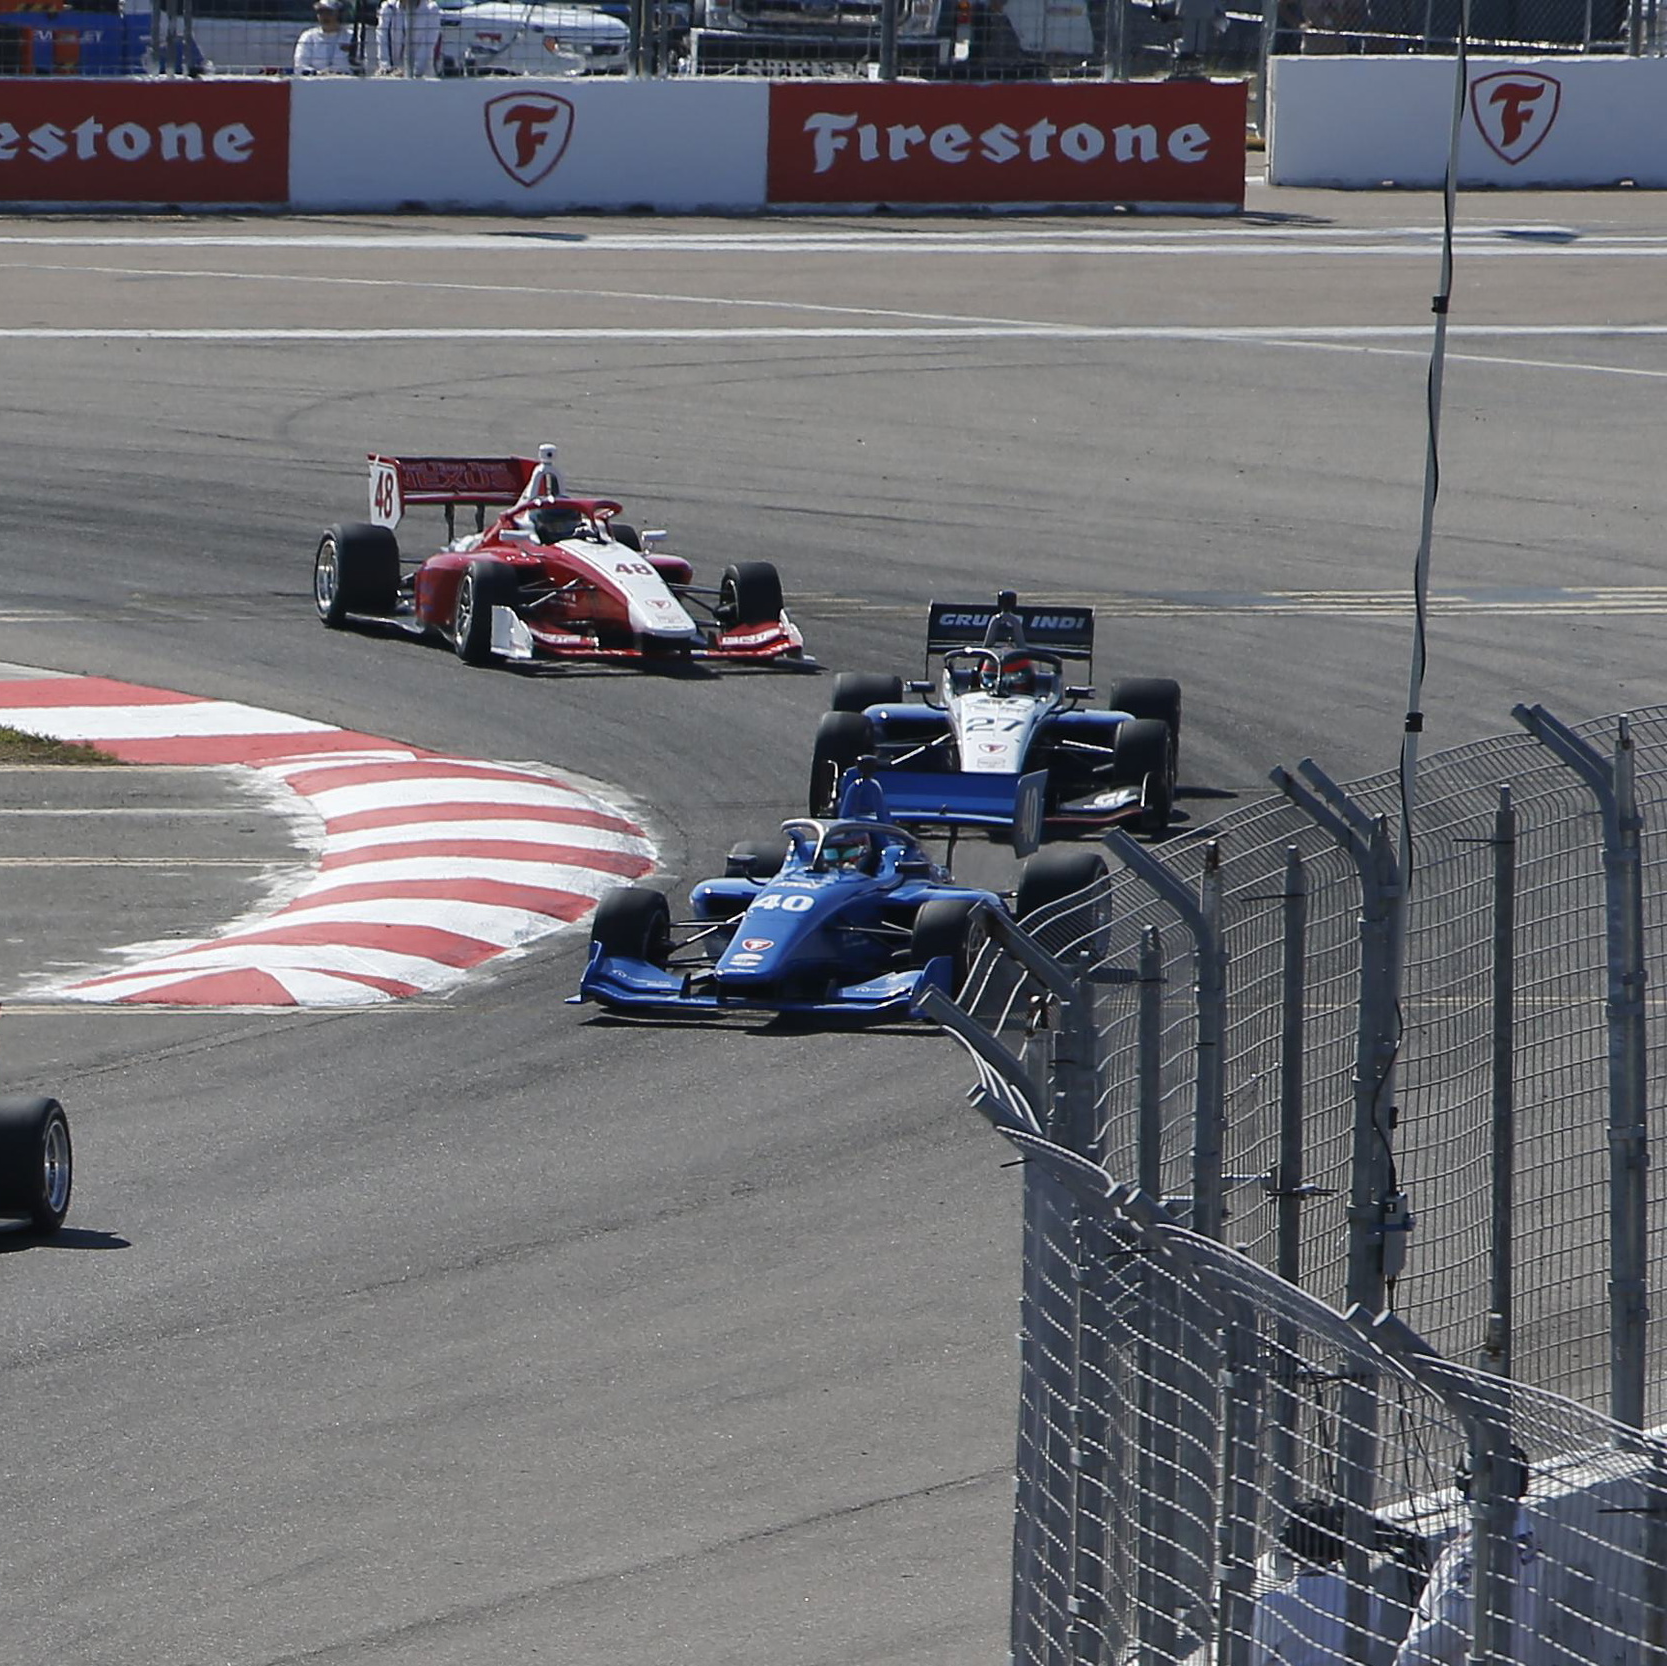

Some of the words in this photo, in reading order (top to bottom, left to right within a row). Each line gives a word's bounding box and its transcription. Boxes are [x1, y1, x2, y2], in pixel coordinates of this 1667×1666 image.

[802, 112, 1211, 174] Firestone
[375, 470, 394, 520] 48
[615, 562, 654, 576] 48
[939, 613, 1024, 627] GRU
[1030, 615, 1086, 630] INDI
[966, 717, 1025, 732] 27
[752, 894, 815, 912] 40
